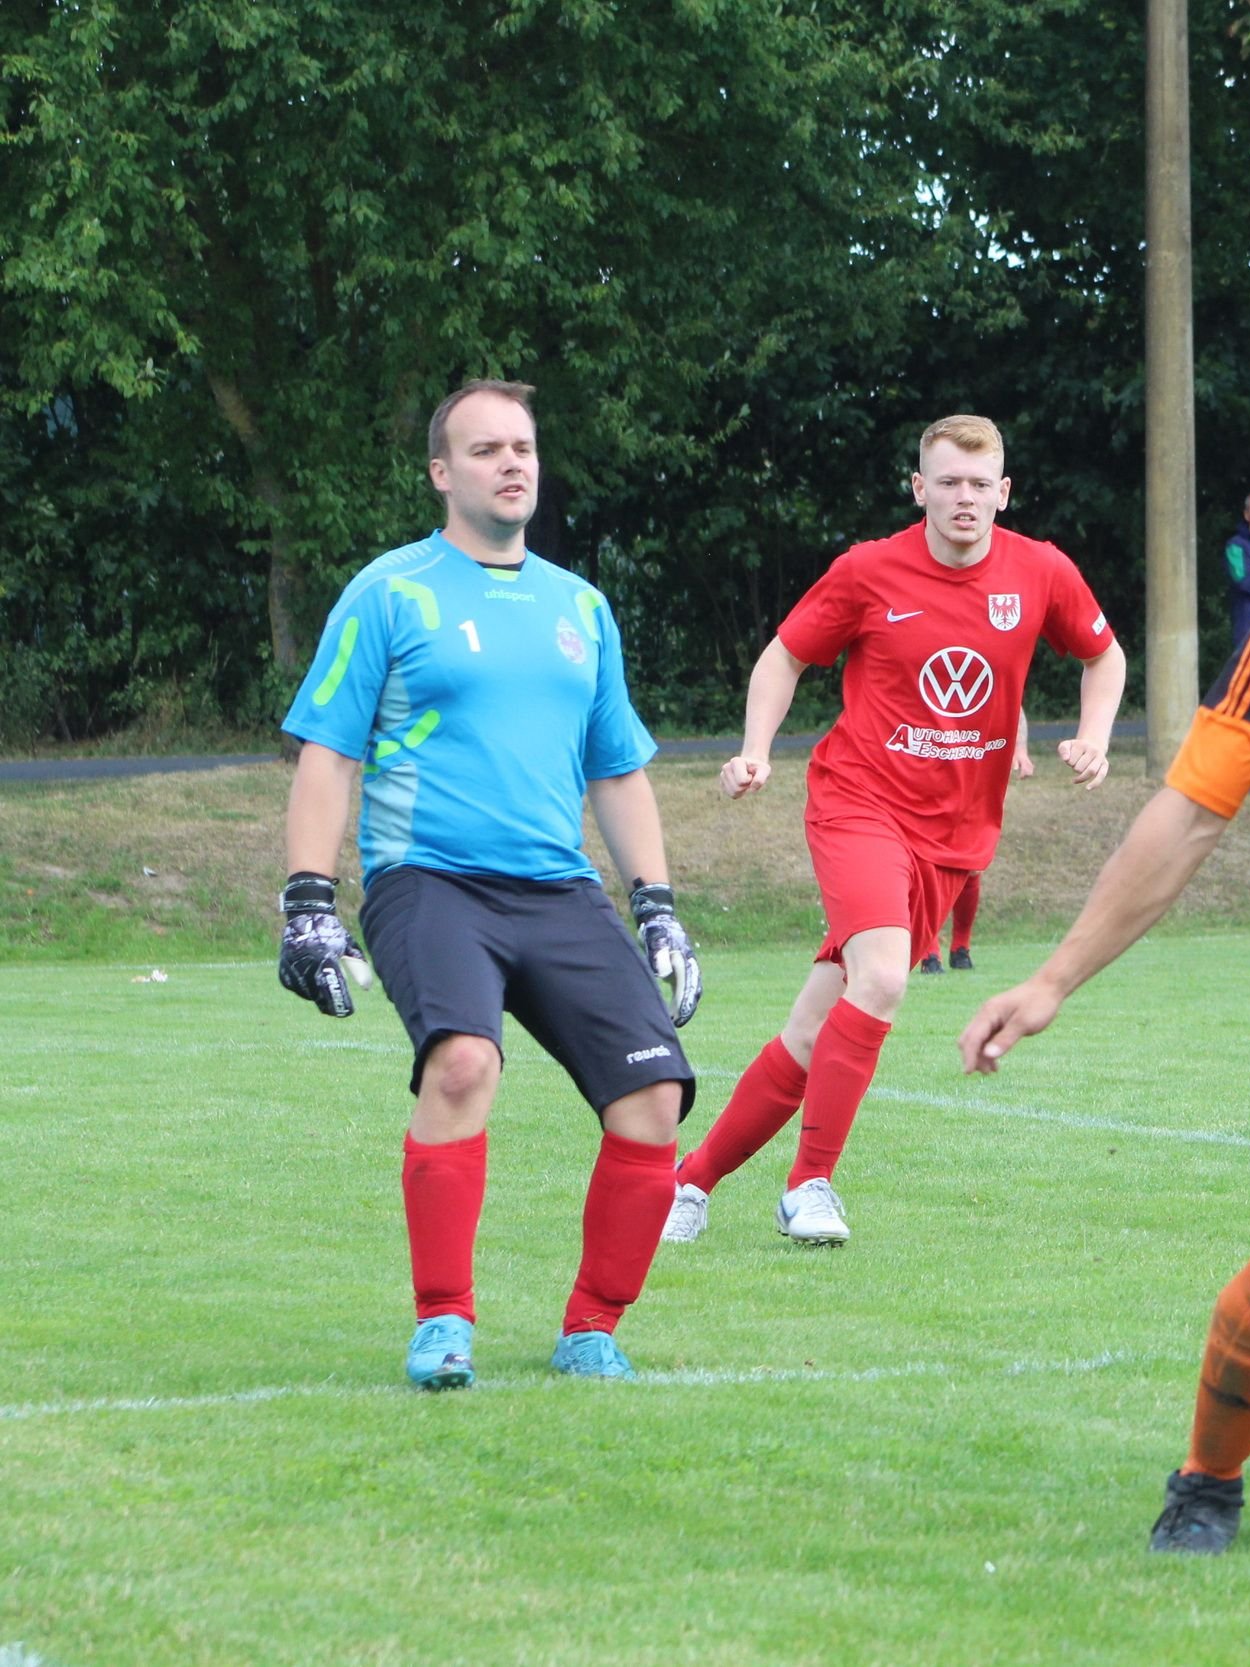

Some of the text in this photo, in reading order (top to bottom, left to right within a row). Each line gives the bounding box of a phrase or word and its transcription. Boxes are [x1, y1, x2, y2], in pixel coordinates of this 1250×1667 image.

[484, 589, 536, 602] uhlsport
[458, 619, 481, 652] 1
[923, 650, 989, 711] VW
[885, 724, 980, 752] AUTOHAUS
[626, 1044, 672, 1065] reusch
